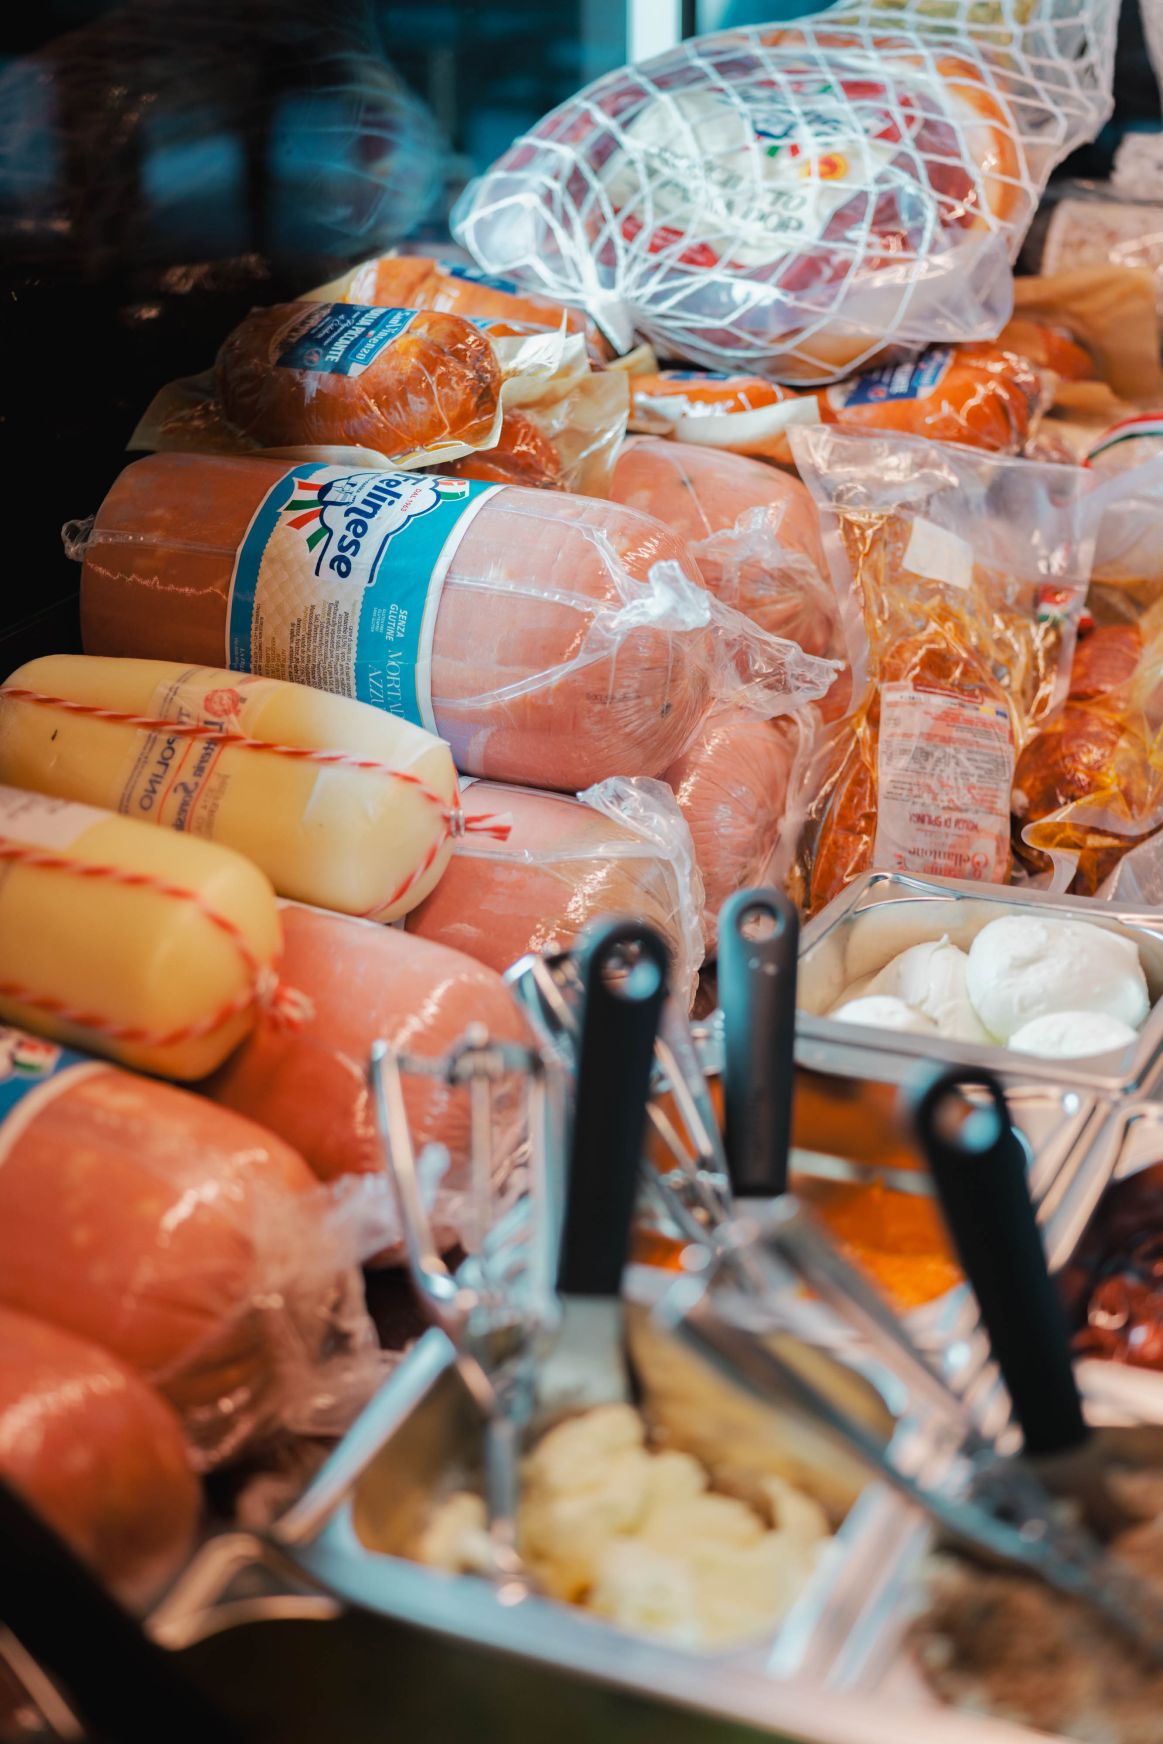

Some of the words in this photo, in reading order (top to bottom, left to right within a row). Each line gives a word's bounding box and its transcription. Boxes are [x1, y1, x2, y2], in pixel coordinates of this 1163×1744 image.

[324, 325, 366, 363] PICCANTE
[329, 473, 428, 579] Felinese
[385, 603, 399, 642] GLUTINE
[395, 608, 408, 638] SENZA
